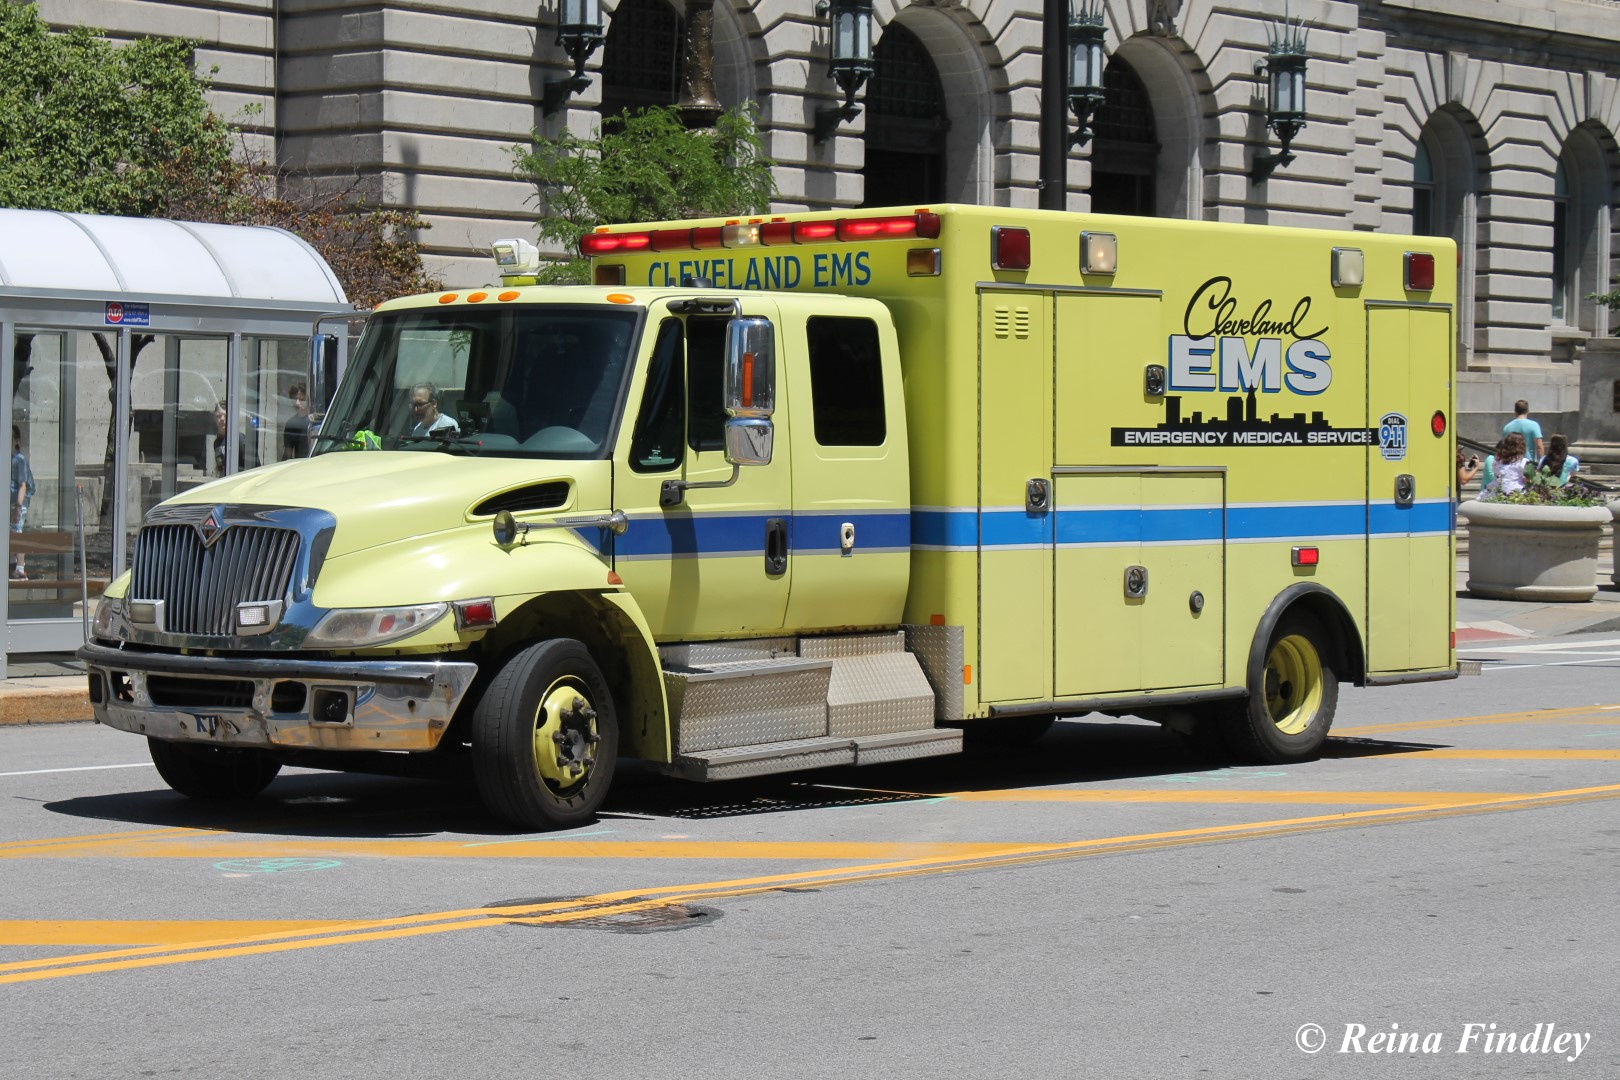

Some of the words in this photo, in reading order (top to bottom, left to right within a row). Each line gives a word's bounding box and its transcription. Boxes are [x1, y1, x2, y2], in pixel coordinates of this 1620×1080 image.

[648, 255, 801, 289] CLEVELAND
[813, 251, 872, 288] EMS
[1184, 276, 1329, 340] Cleveland
[1168, 334, 1333, 396] EMS
[1124, 431, 1227, 444] EMERGENCY
[1233, 431, 1303, 444] MEDICAL
[1307, 431, 1372, 443] SERVICE
